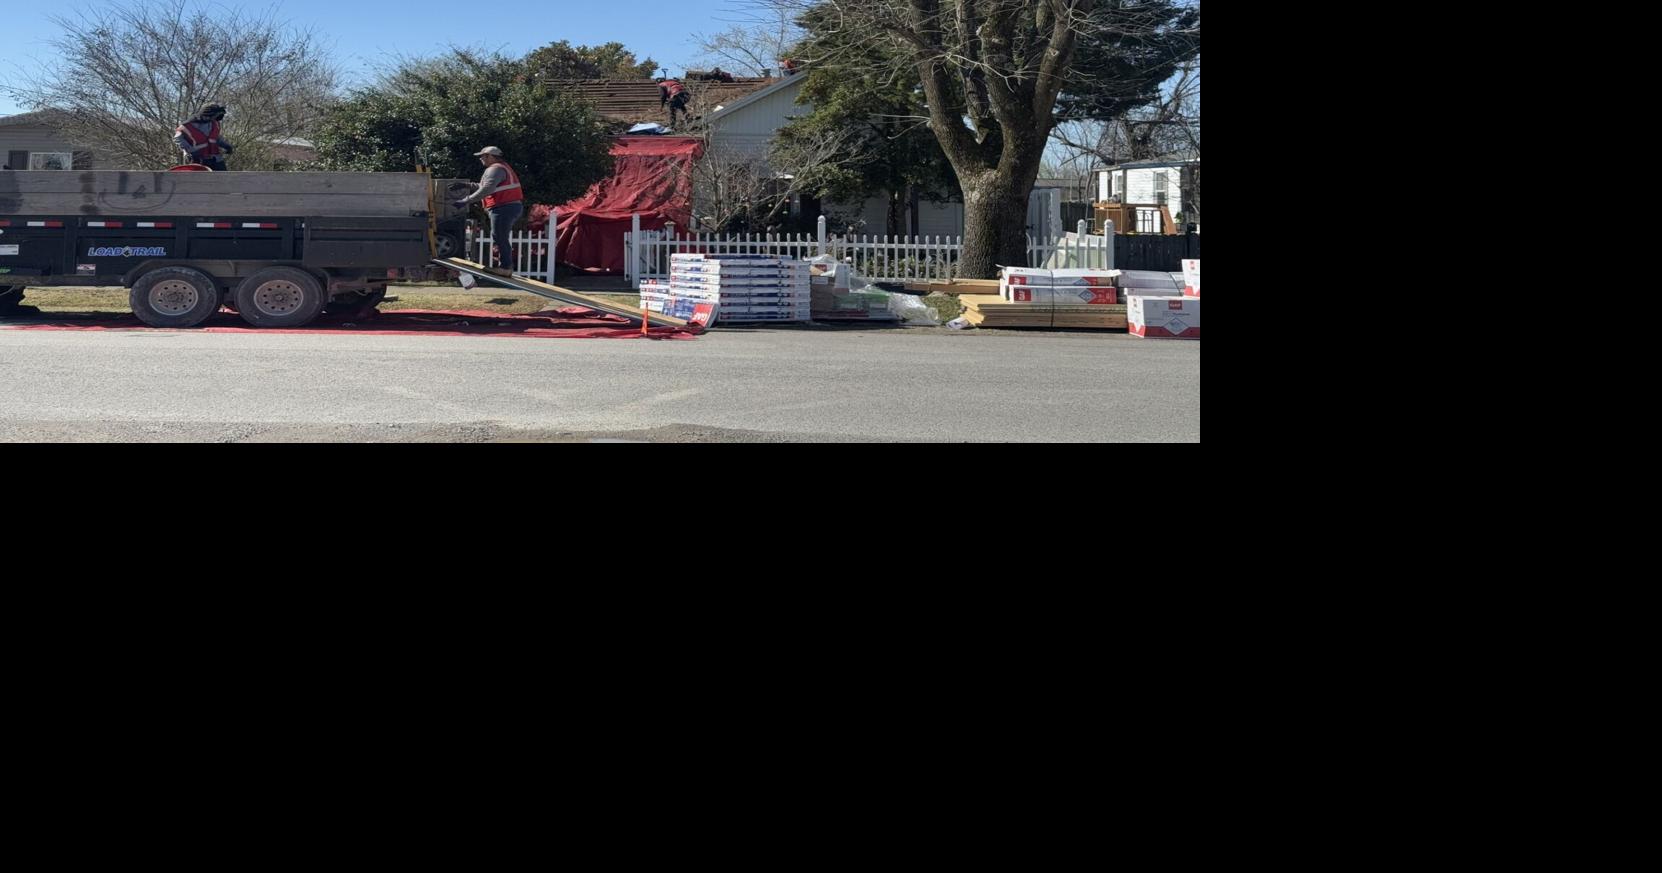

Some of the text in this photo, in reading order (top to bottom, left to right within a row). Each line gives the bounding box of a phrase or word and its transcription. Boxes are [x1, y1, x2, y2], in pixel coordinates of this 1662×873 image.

[88, 246, 167, 257] LOAD TRAIL
[692, 312, 708, 321] GAF
